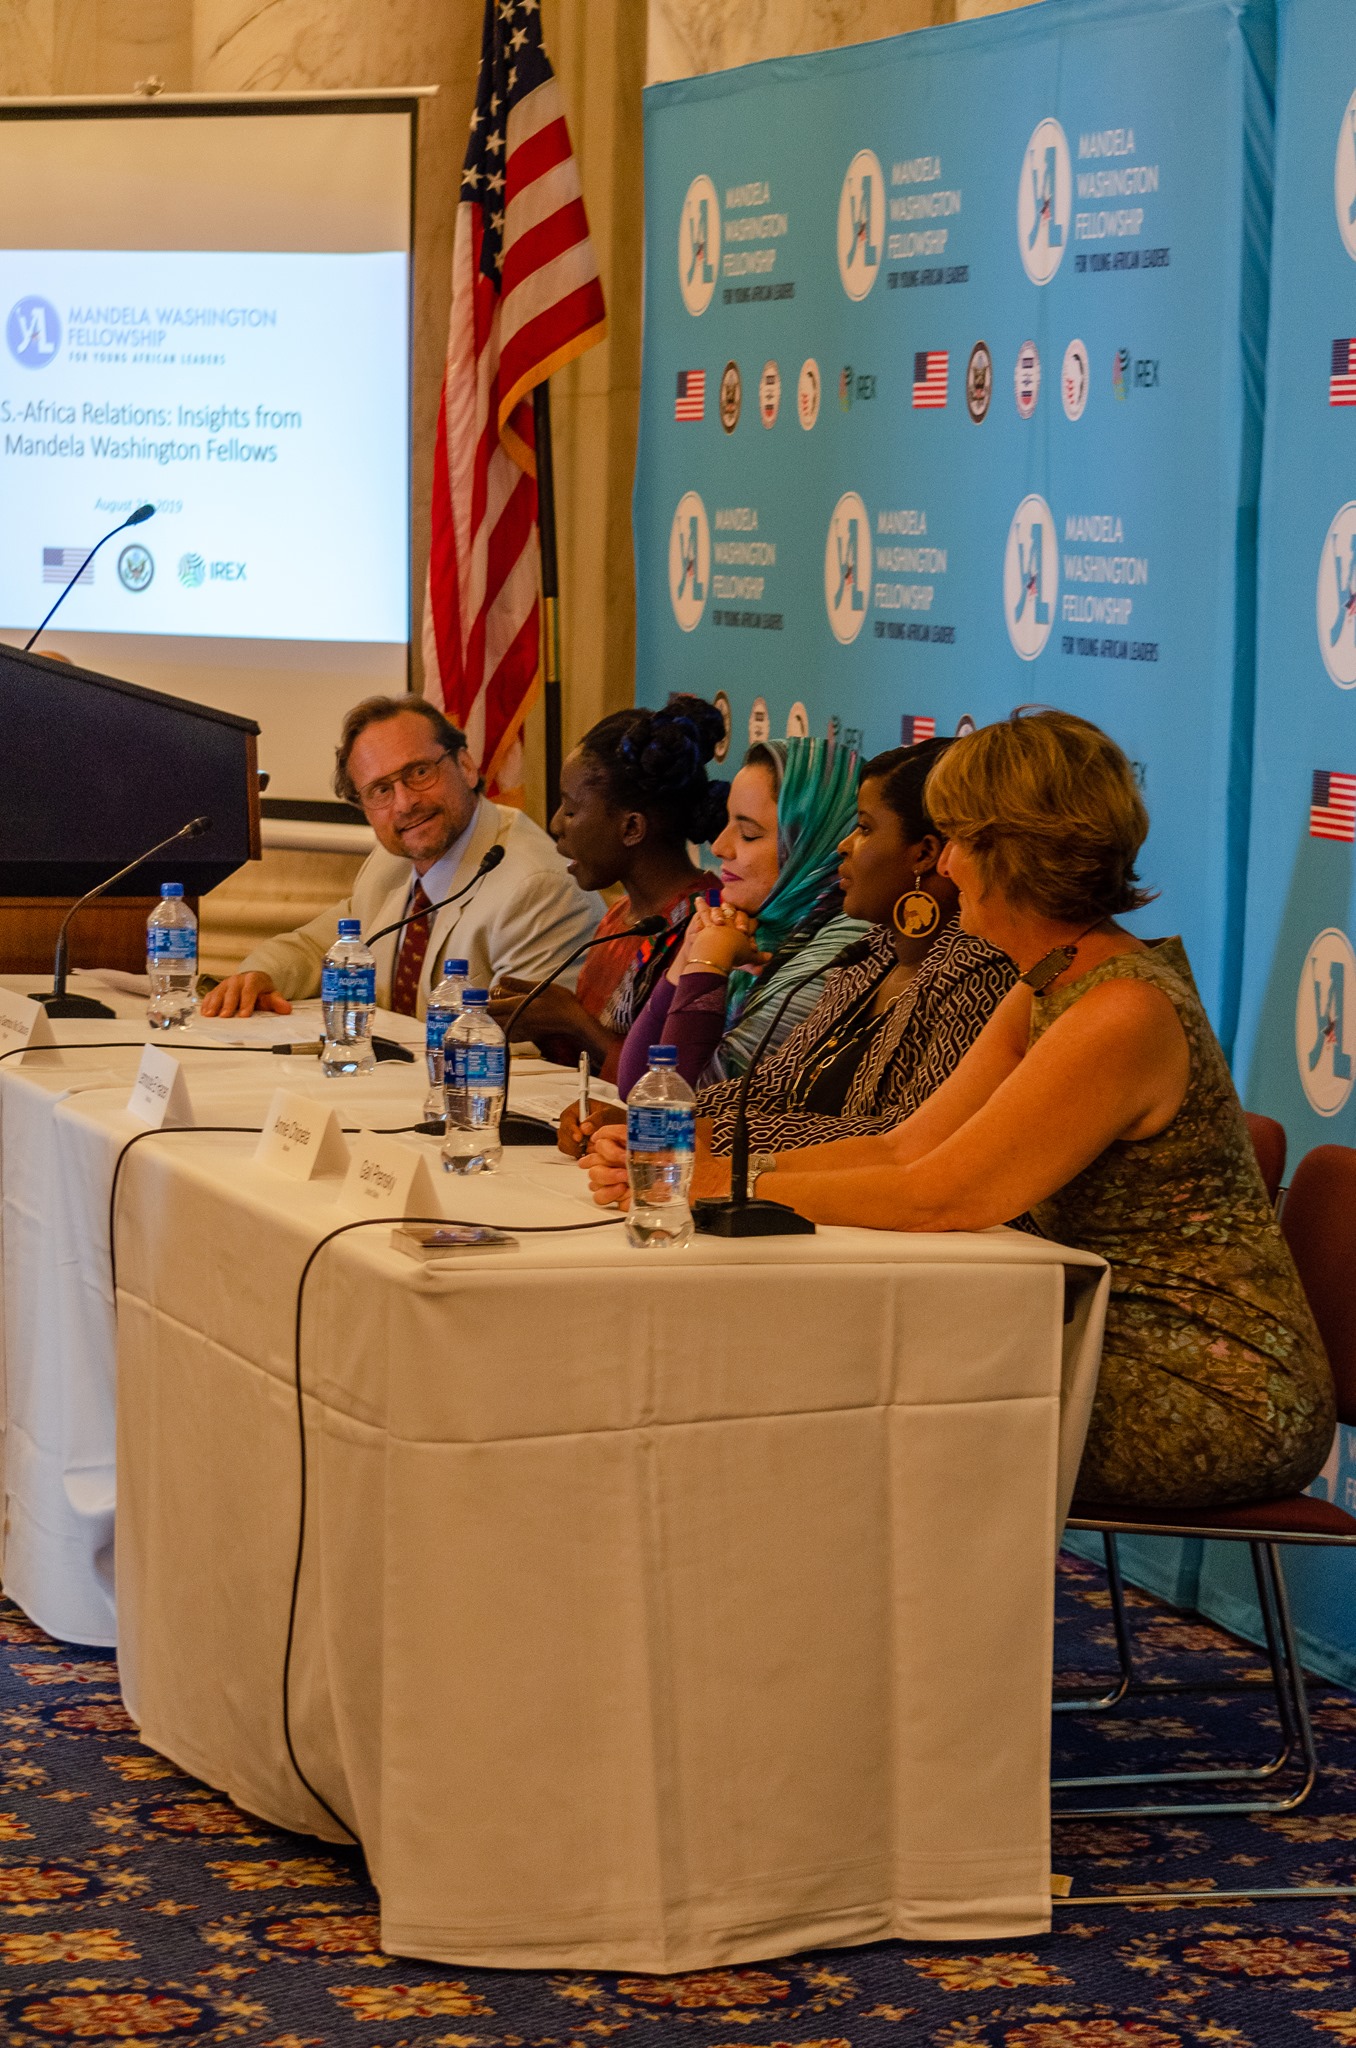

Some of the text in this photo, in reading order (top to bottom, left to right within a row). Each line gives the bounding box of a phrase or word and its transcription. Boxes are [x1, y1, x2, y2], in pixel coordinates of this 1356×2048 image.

[1078, 128, 1136, 159] MANDELA
[891, 156, 941, 186] MANDELA
[1077, 165, 1159, 199] WASHINGTON
[890, 190, 961, 221] WASHINGTON
[1075, 207, 1144, 240] FELLOWSHIP
[887, 228, 948, 259] FELLOWSHIP
[68, 306, 277, 328] MANDELA WASHINGTON
[68, 327, 167, 348] FELLOWSHIP
[69, 351, 226, 367] FOR YOUNG AFRICAN LEADERS
[82, 400, 172, 427] Relations:
[177, 403, 250, 433] Insights
[256, 403, 302, 429] from
[5, 433, 278, 466] Mandela Washington Fellows
[94, 497, 132, 514] August
[877, 510, 927, 535] MANDELA
[1065, 515, 1124, 543] MANDELA
[210, 561, 247, 581] IREX
[876, 546, 947, 573] WASHINGTON
[1064, 554, 1148, 585] WASHINGTON
[874, 583, 934, 610] FELLOWSHIP
[1062, 594, 1133, 625] FELLOWSHIP
